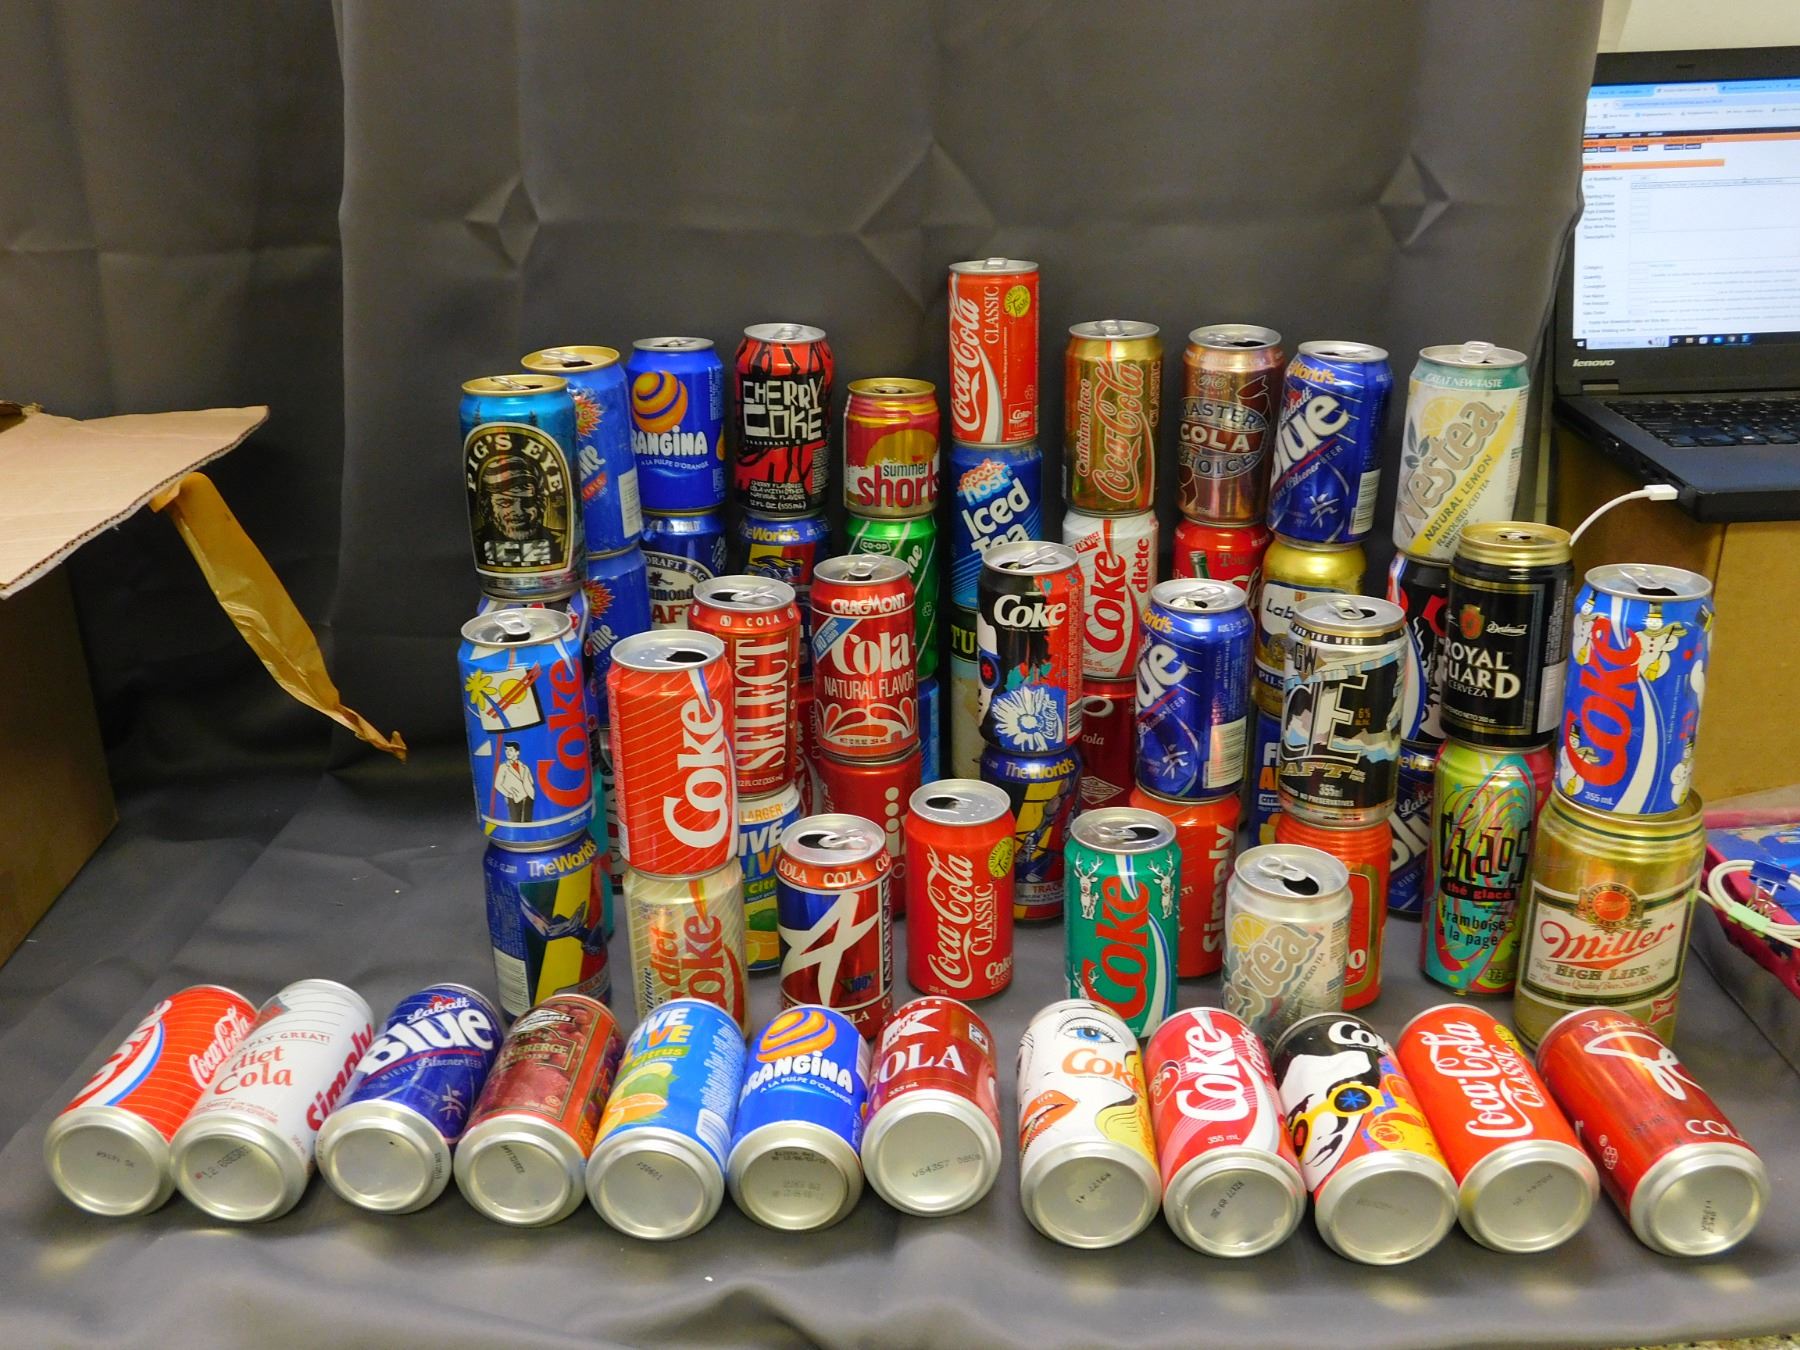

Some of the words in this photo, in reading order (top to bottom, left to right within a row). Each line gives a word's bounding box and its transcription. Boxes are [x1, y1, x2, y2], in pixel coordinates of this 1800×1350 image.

[984, 286, 1000, 344] CLASSIC
[1572, 358, 1615, 368] lenovo
[743, 377, 824, 410] CHERRY
[1080, 379, 1091, 413] Free
[1150, 361, 1161, 427] CLASSIC
[1454, 374, 1475, 387] NEW
[1478, 377, 1504, 388] TASTE
[743, 404, 822, 441] COKE
[1092, 358, 1144, 503] Coca-Cola
[1180, 423, 1250, 452] COLA
[1076, 414, 1091, 477] Caffeine
[1320, 445, 1343, 464] BEER
[468, 434, 512, 492] PIG'S
[521, 438, 564, 492] EYE
[654, 459, 673, 467] PULPE
[883, 462, 927, 477] summer
[963, 463, 992, 487] good
[961, 478, 1031, 539] Iced
[1424, 496, 1463, 541] NATURAL
[1461, 454, 1493, 495] LEMON
[862, 541, 888, 550] CO-OP
[831, 593, 906, 616] CRAGMONT
[994, 595, 1067, 628] Coke
[1084, 551, 1126, 653] Coke
[746, 616, 780, 627] COLA
[1143, 608, 1172, 634] orld's
[831, 632, 910, 675] Cola
[1311, 633, 1328, 642] THE
[1336, 637, 1363, 645] WEST
[1445, 637, 1509, 669] ROYAL
[824, 676, 877, 700] NATURAL
[880, 670, 914, 697] FLAVOR
[1449, 680, 1488, 698] CERVEZA
[735, 637, 790, 770] SELECT
[537, 659, 590, 807] Coke
[1082, 733, 1104, 745] cola
[663, 699, 729, 848] Coke
[740, 804, 782, 823] LARGER
[778, 858, 808, 884] COLA
[823, 871, 867, 887] COLA
[1473, 887, 1511, 901] glacé
[883, 879, 894, 981] AMERICAN
[927, 845, 973, 988] Coca-Cola
[971, 883, 993, 956] CLASSIC
[1441, 904, 1505, 932] framboise
[650, 926, 681, 986] diet
[1081, 876, 1150, 1019] Coke
[1449, 929, 1460, 941] la
[1465, 934, 1499, 950] page
[1540, 921, 1675, 959] Miller
[672, 915, 727, 1010] oke
[1555, 965, 1602, 980] HIGH
[1608, 965, 1650, 980] LIFE
[407, 997, 470, 1023] Labatt
[280, 1031, 331, 1043] GREAT!
[356, 1009, 494, 1075] Blue
[232, 1046, 285, 1071] diet
[879, 1043, 968, 1084] OLA
[1176, 1026, 1250, 1121] Coke
[214, 1062, 293, 1095] Cola
[781, 1076, 808, 1084] PULPE
[809, 1080, 852, 1106] D'ORANGE
[1418, 1021, 1534, 1137] Coca-Cola
[1488, 1045, 1544, 1107] CLASSIC
[1208, 1135, 1224, 1144] 355
